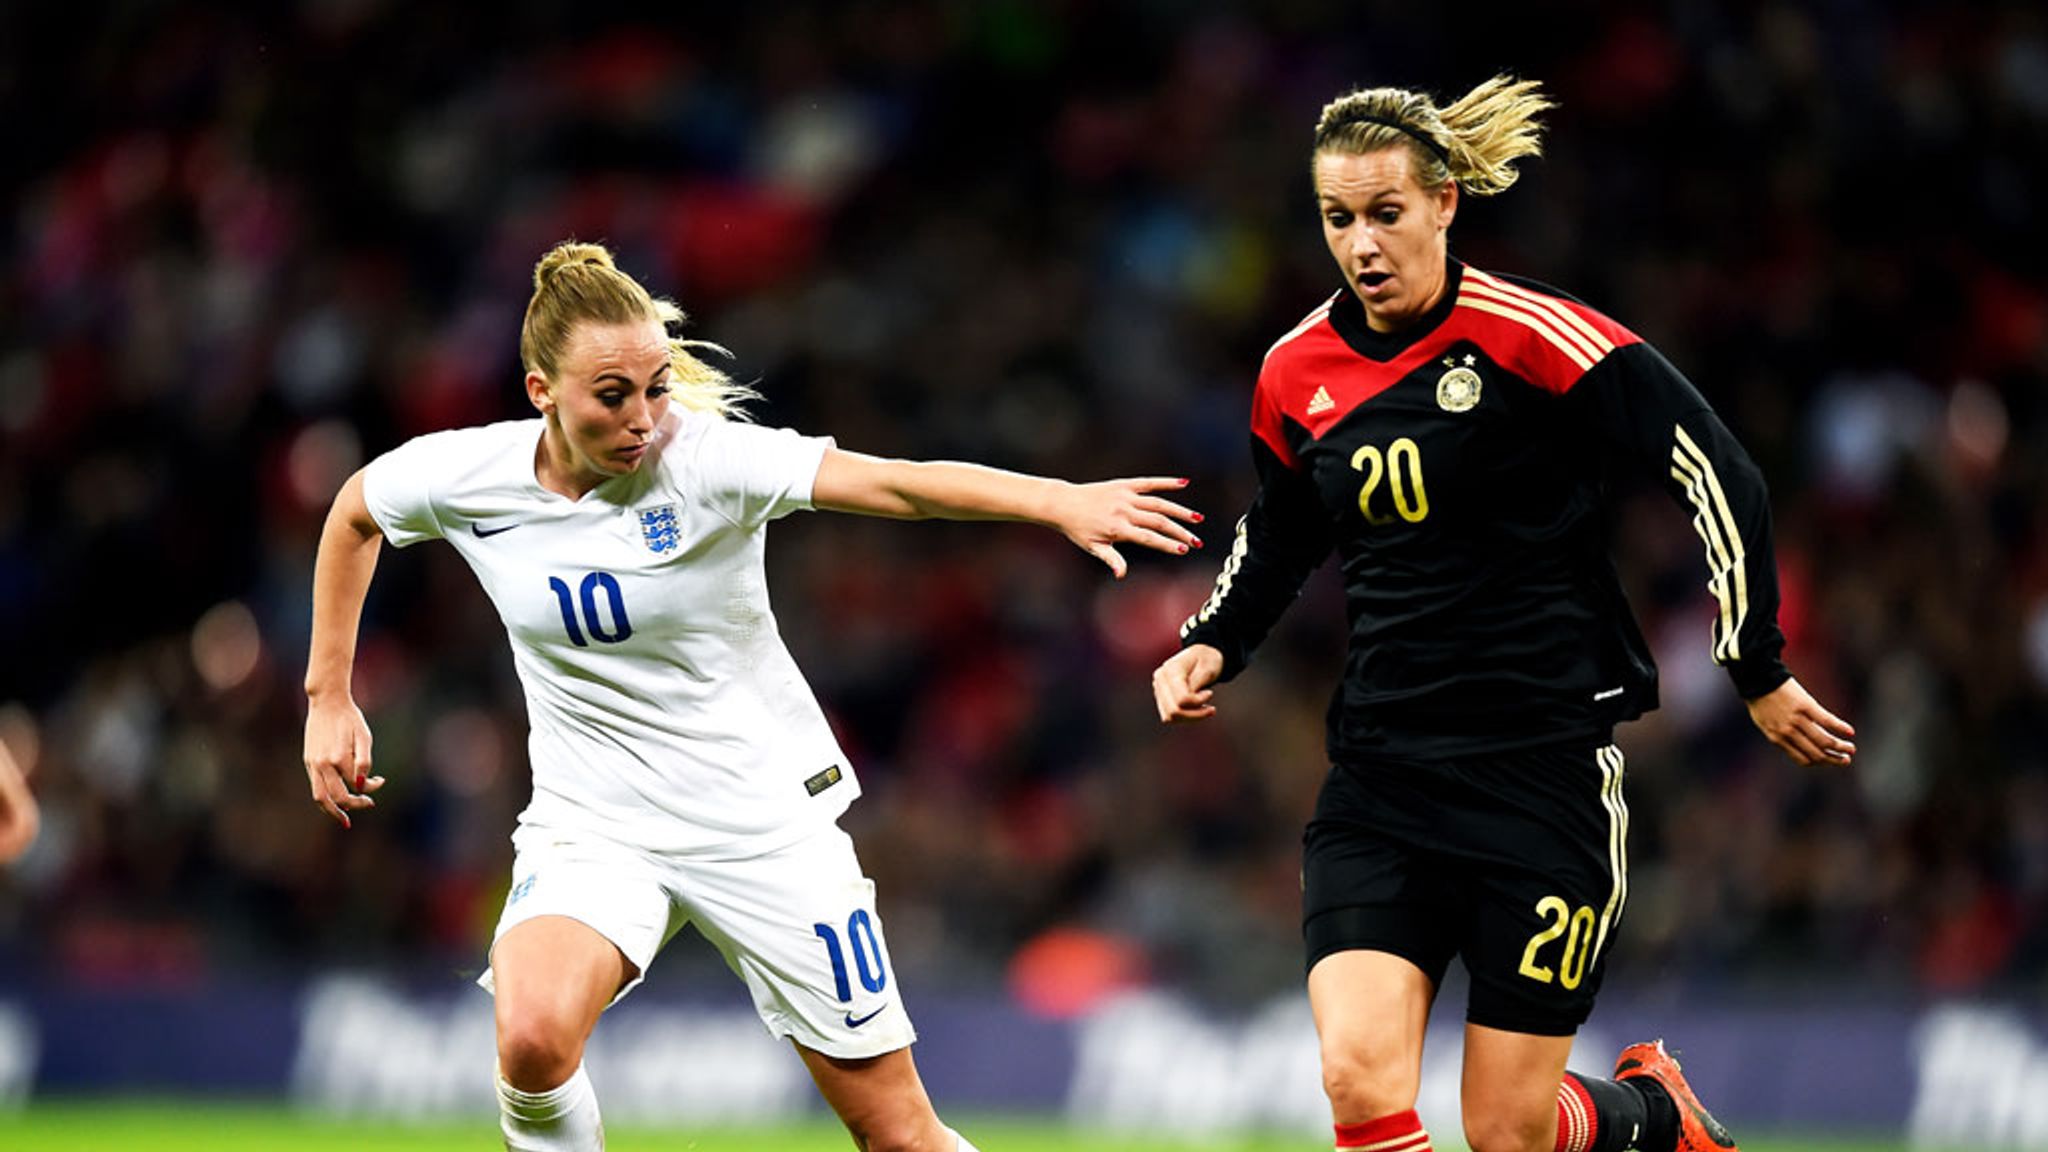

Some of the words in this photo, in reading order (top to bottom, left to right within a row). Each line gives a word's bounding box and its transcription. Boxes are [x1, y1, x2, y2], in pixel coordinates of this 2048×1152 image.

[1351, 437, 1429, 526] 20
[548, 571, 632, 647] 10
[813, 908, 886, 1003] 10
[1518, 895, 1595, 990] 20
